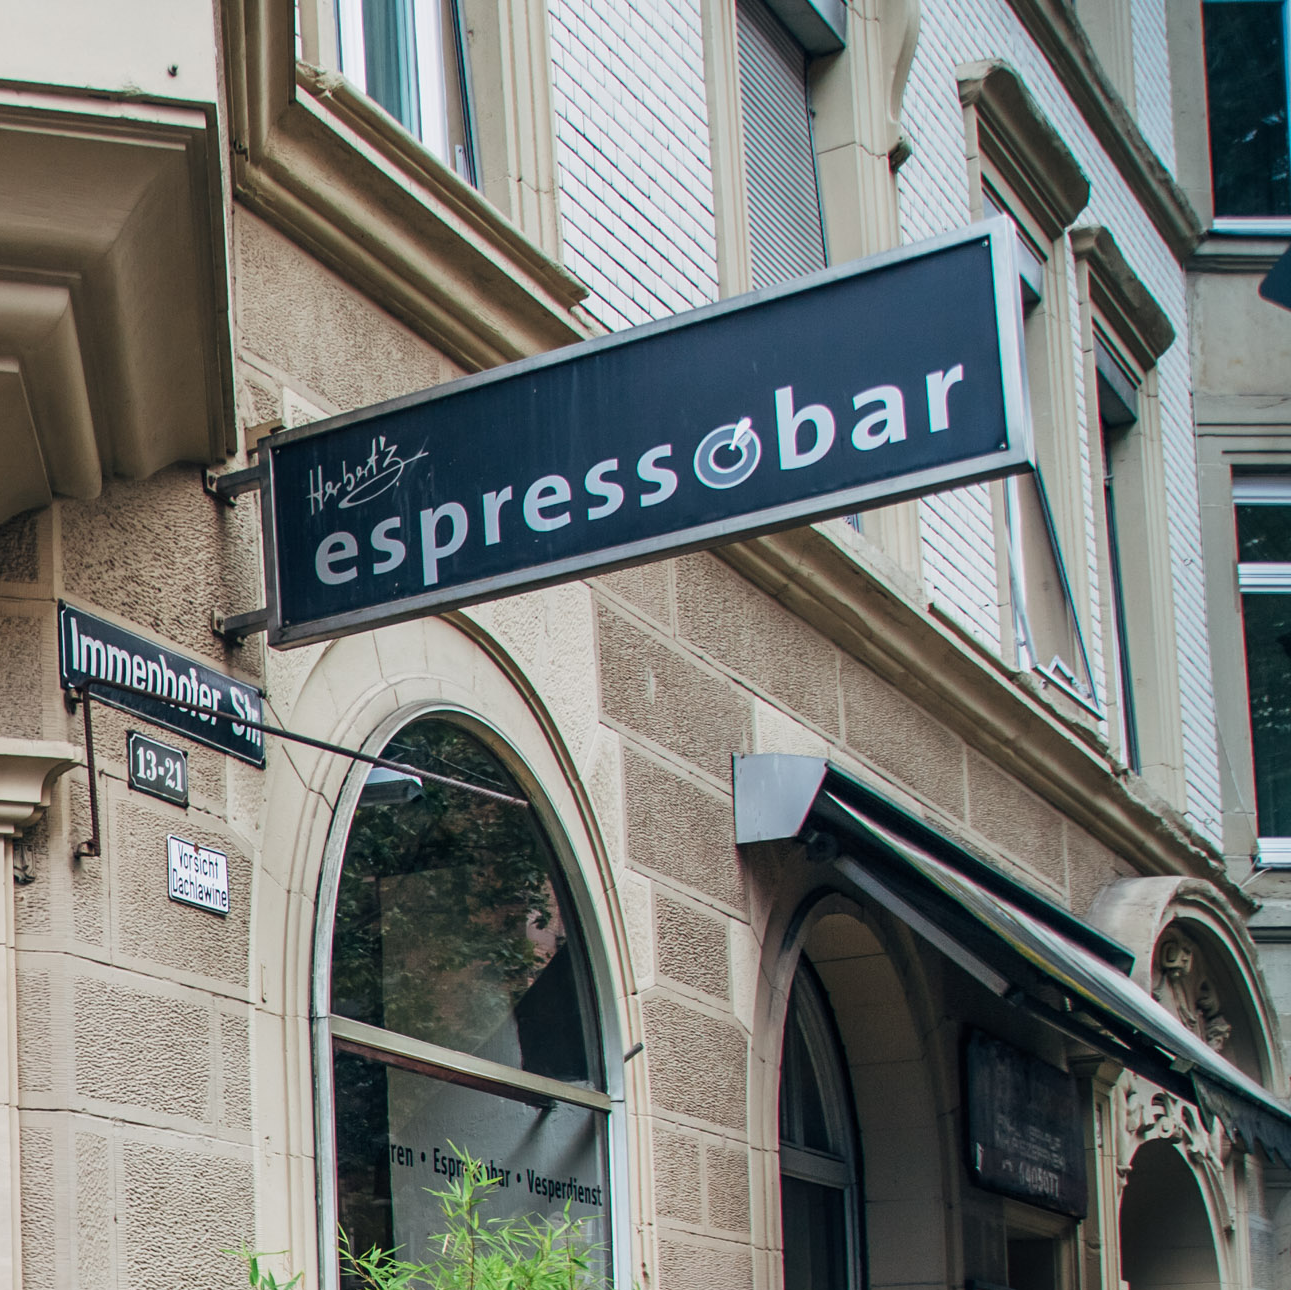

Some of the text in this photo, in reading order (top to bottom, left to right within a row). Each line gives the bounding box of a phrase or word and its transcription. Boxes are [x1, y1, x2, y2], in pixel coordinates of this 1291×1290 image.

[70, 616, 222, 726] Immenhofer
[136, 746, 185, 793] 13-21
[177, 842, 219, 880] Vorsicht
[172, 867, 228, 909] Dachlawine
[527, 1169, 603, 1206] Vesperdienst
